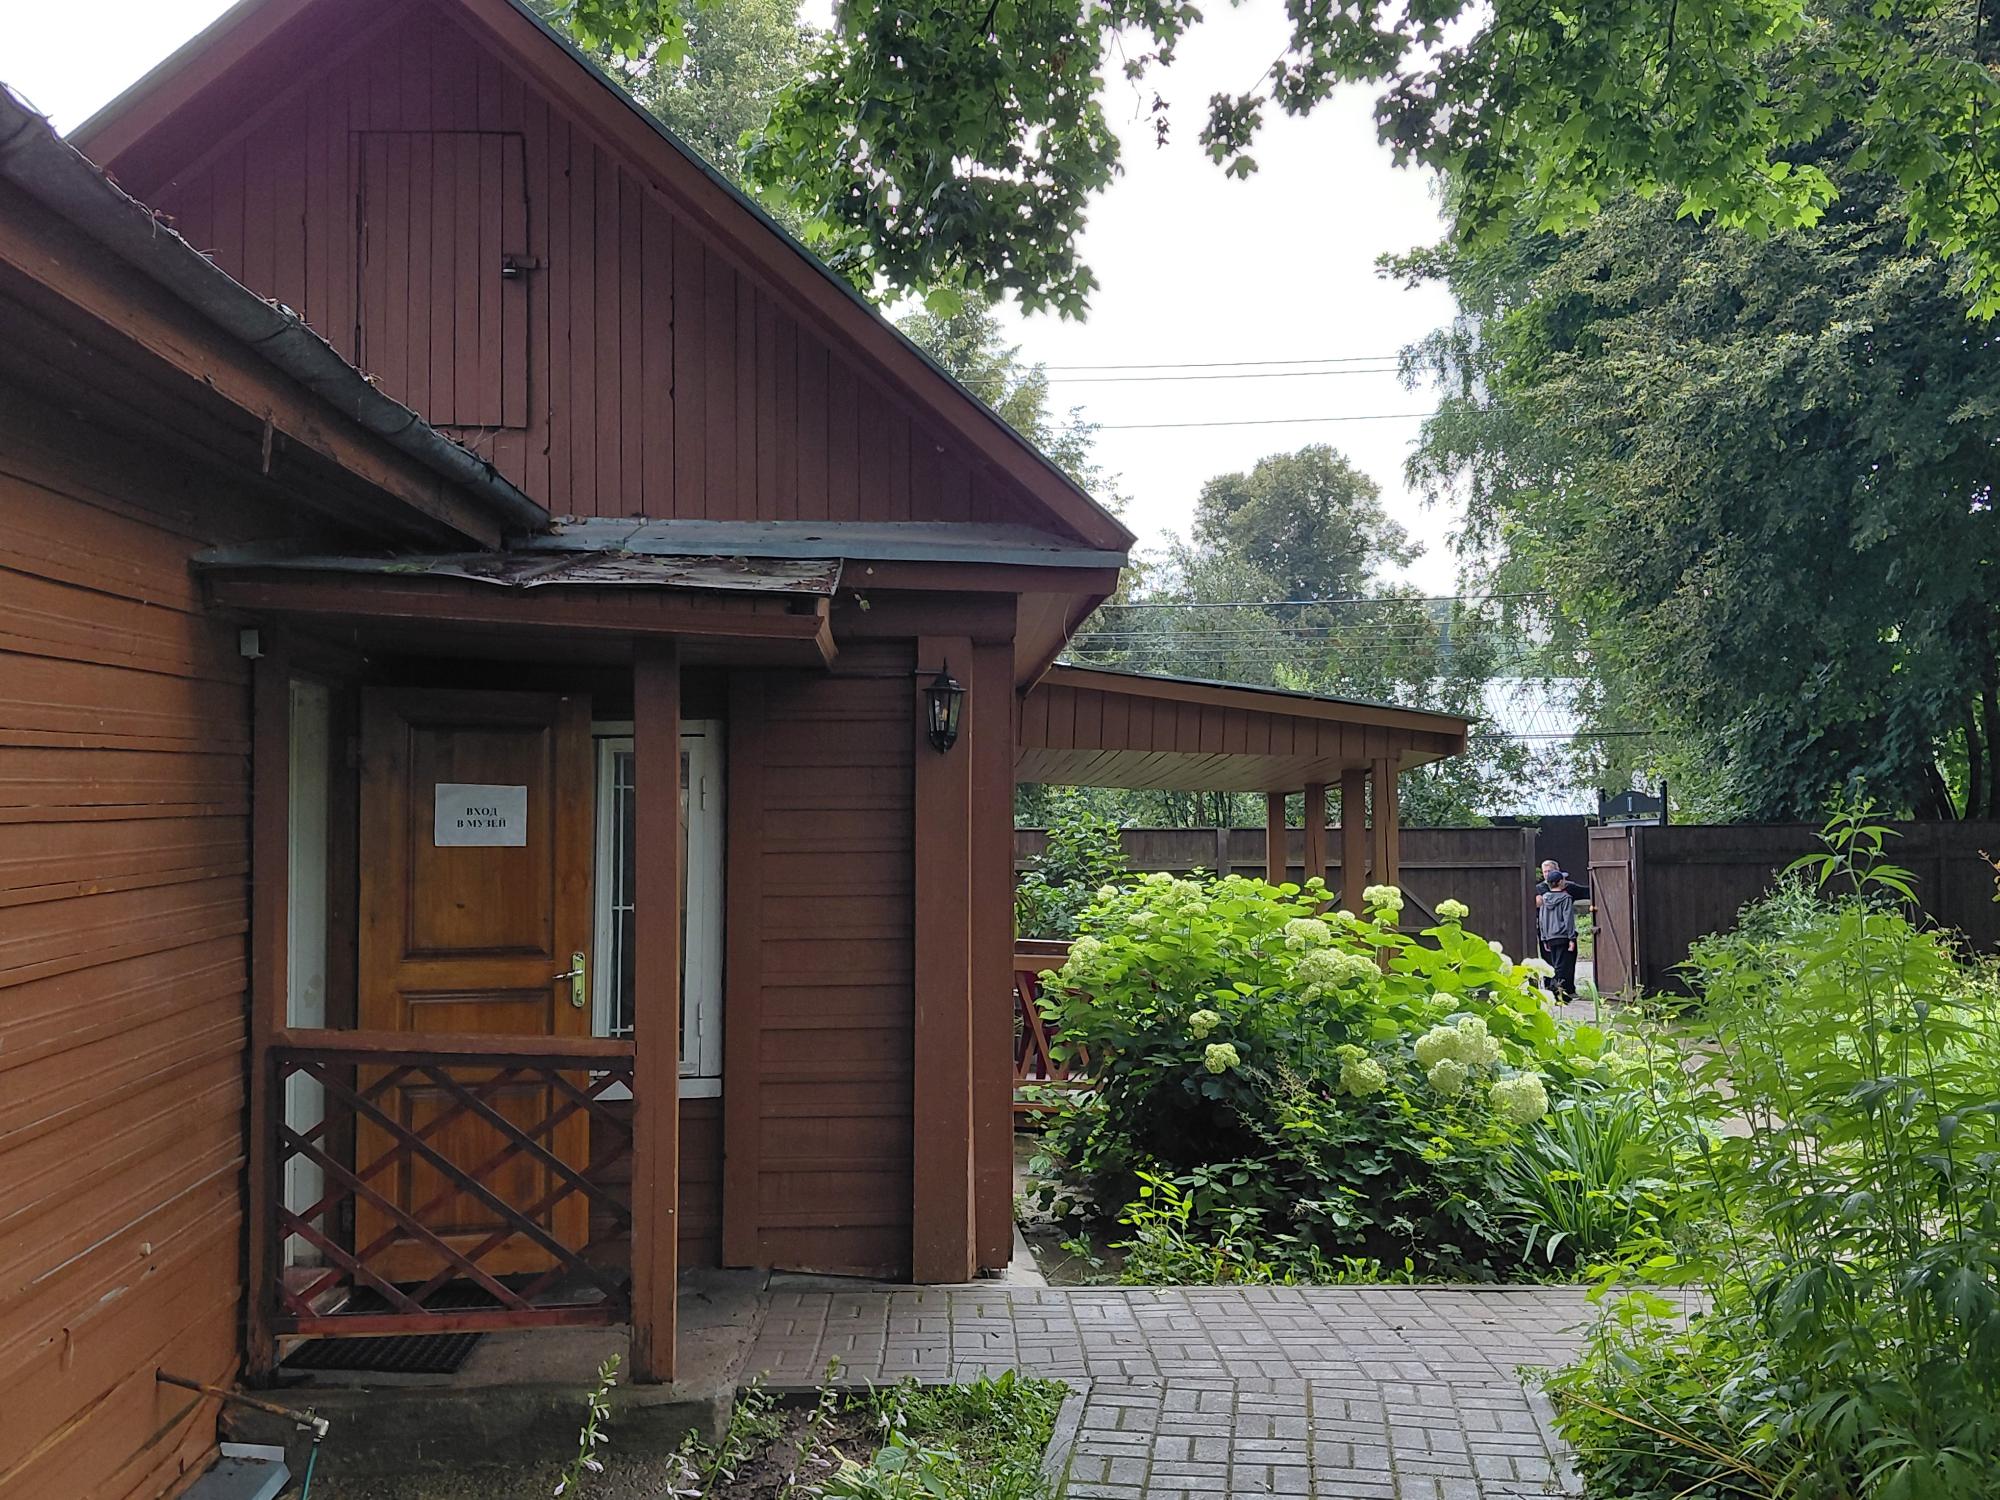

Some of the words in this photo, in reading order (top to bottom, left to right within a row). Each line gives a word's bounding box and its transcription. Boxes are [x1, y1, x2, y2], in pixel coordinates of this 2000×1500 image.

[466, 807, 498, 817] ВХОД
[457, 819, 464, 828] В
[467, 817, 506, 828] МУЗЕЙ
